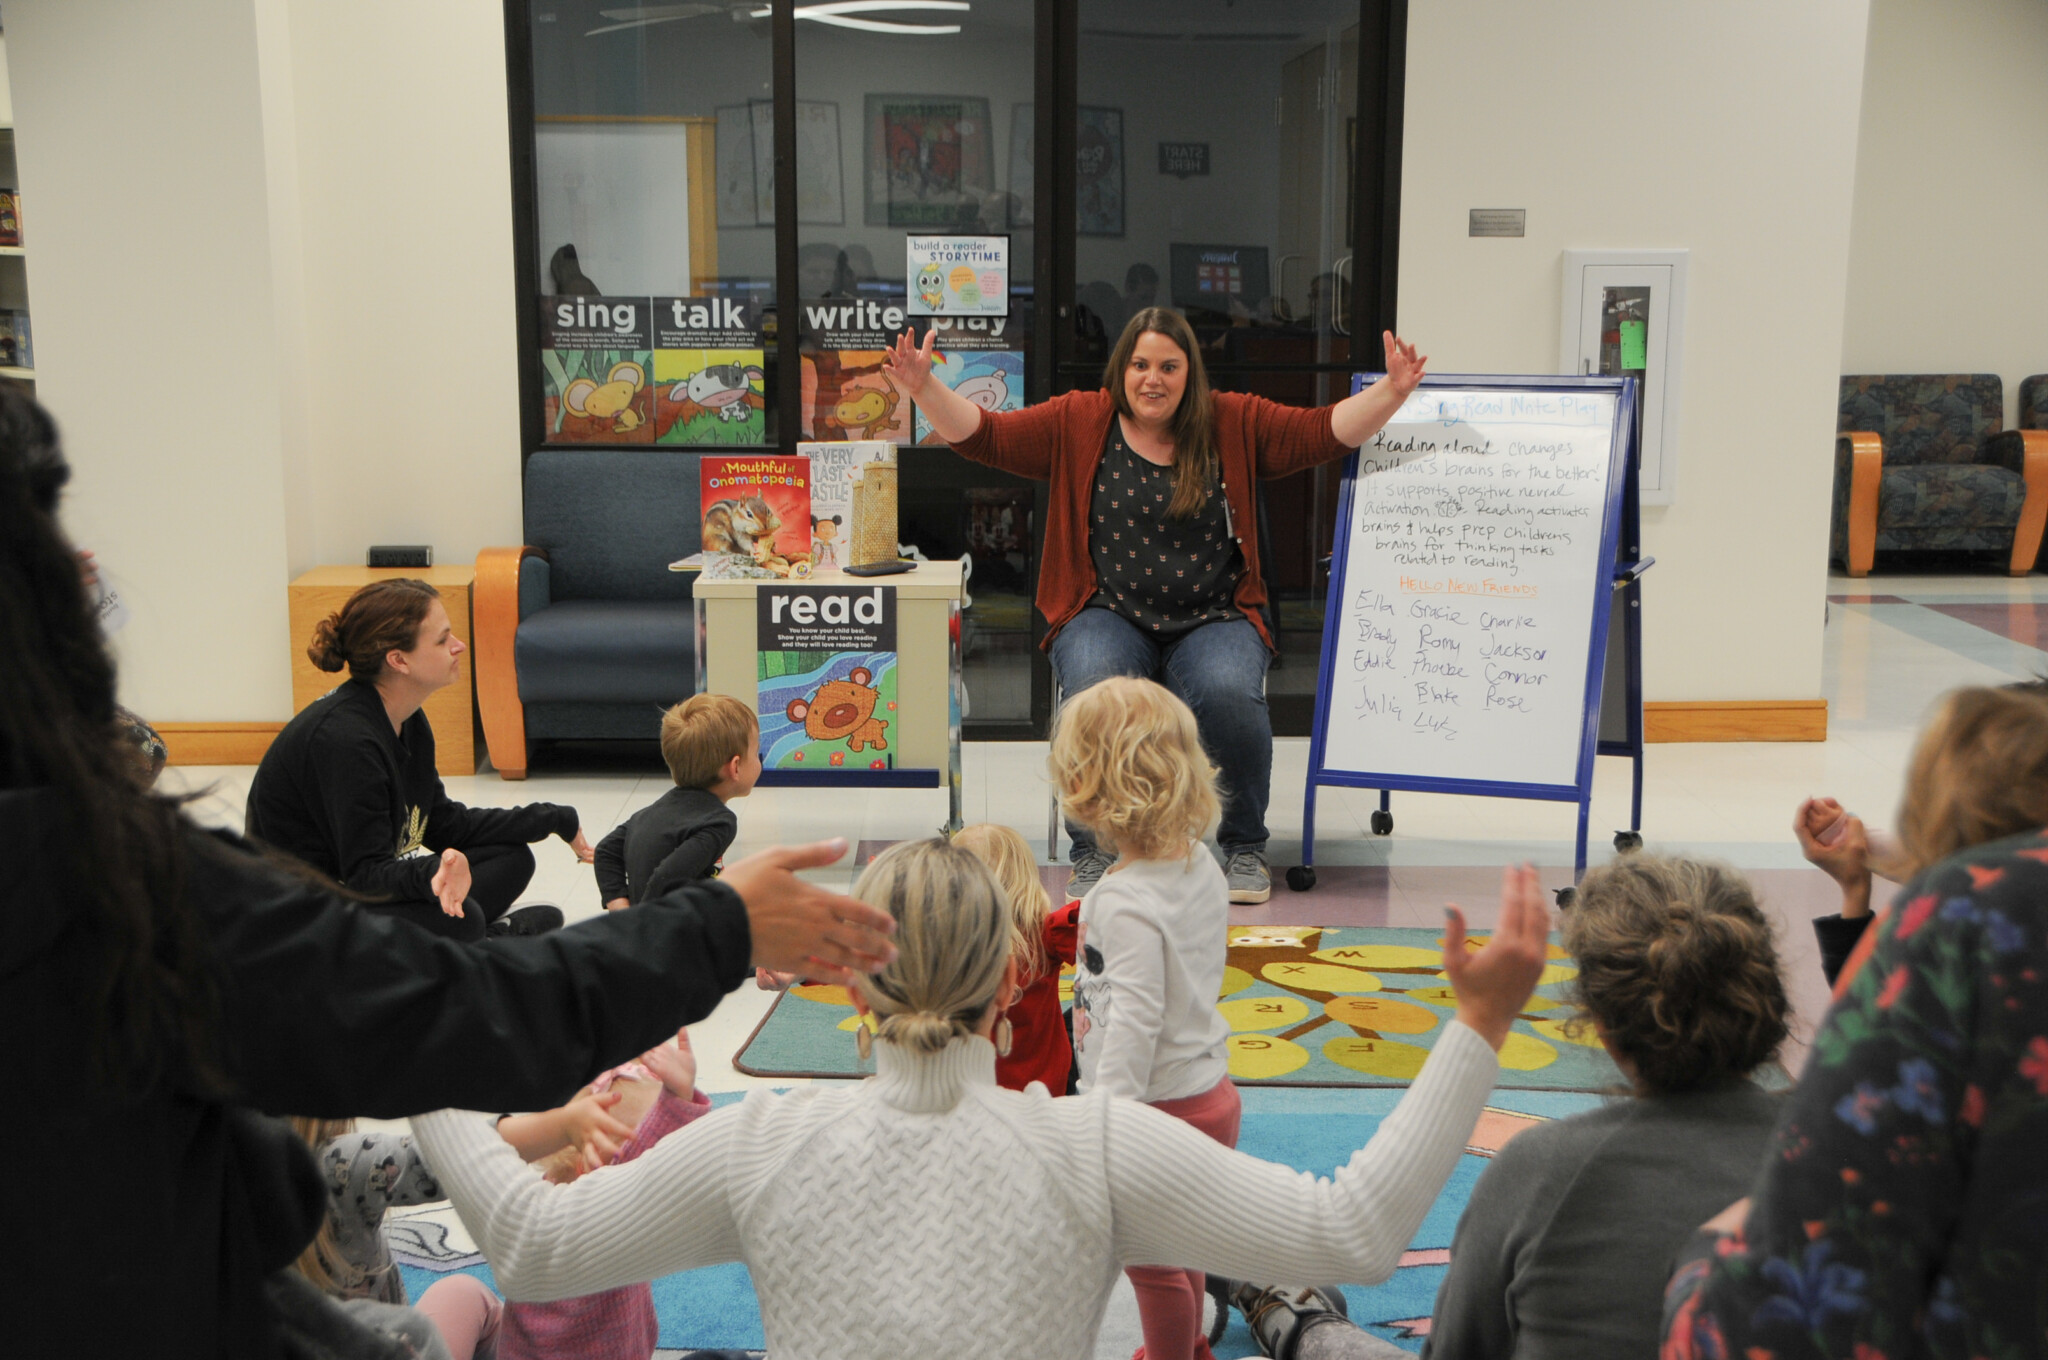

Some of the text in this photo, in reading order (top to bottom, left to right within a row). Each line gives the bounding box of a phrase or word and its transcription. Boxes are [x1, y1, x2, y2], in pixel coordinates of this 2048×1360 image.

[913, 241, 940, 250] build
[953, 241, 987, 250] reader
[930, 252, 1001, 261] STORYTIME
[557, 296, 636, 334] sing
[672, 297, 745, 329] talk
[806, 299, 904, 330] write
[931, 317, 1007, 336] play
[1418, 394, 1459, 427] Sing
[1463, 394, 1503, 417] Read
[1560, 396, 1598, 424] Play
[820, 448, 855, 464] VERY
[1374, 430, 1437, 462] Reading
[1442, 438, 1499, 455] aloud
[726, 460, 786, 474] Mouthful
[812, 465, 845, 482] LAST
[1445, 460, 1494, 476] brains
[1501, 463, 1520, 479] for
[1528, 464, 1551, 479] the
[709, 473, 805, 488] Onomatopoeia
[1366, 480, 1575, 502] It supports positive neural
[810, 482, 853, 502] ASTLE
[1474, 499, 1534, 525] Reading
[1362, 519, 1400, 534] brains
[1462, 524, 1495, 540] prep
[1375, 536, 1554, 563] brains for thinking tasks
[1393, 552, 1437, 565] related
[1441, 553, 1455, 565] to
[1400, 575, 1443, 591] HELLO
[1482, 577, 1539, 596] FRIENDS
[771, 586, 883, 625] read
[1355, 590, 1536, 630] Ella Gracie Charlie
[1358, 619, 1397, 658] Brady
[1419, 624, 1461, 658] Romy
[1353, 650, 1396, 672] Eddie
[1484, 662, 1548, 685] Connor
[1354, 682, 1532, 721] Julia Blake Rose
[1282, 965, 1307, 974] X
